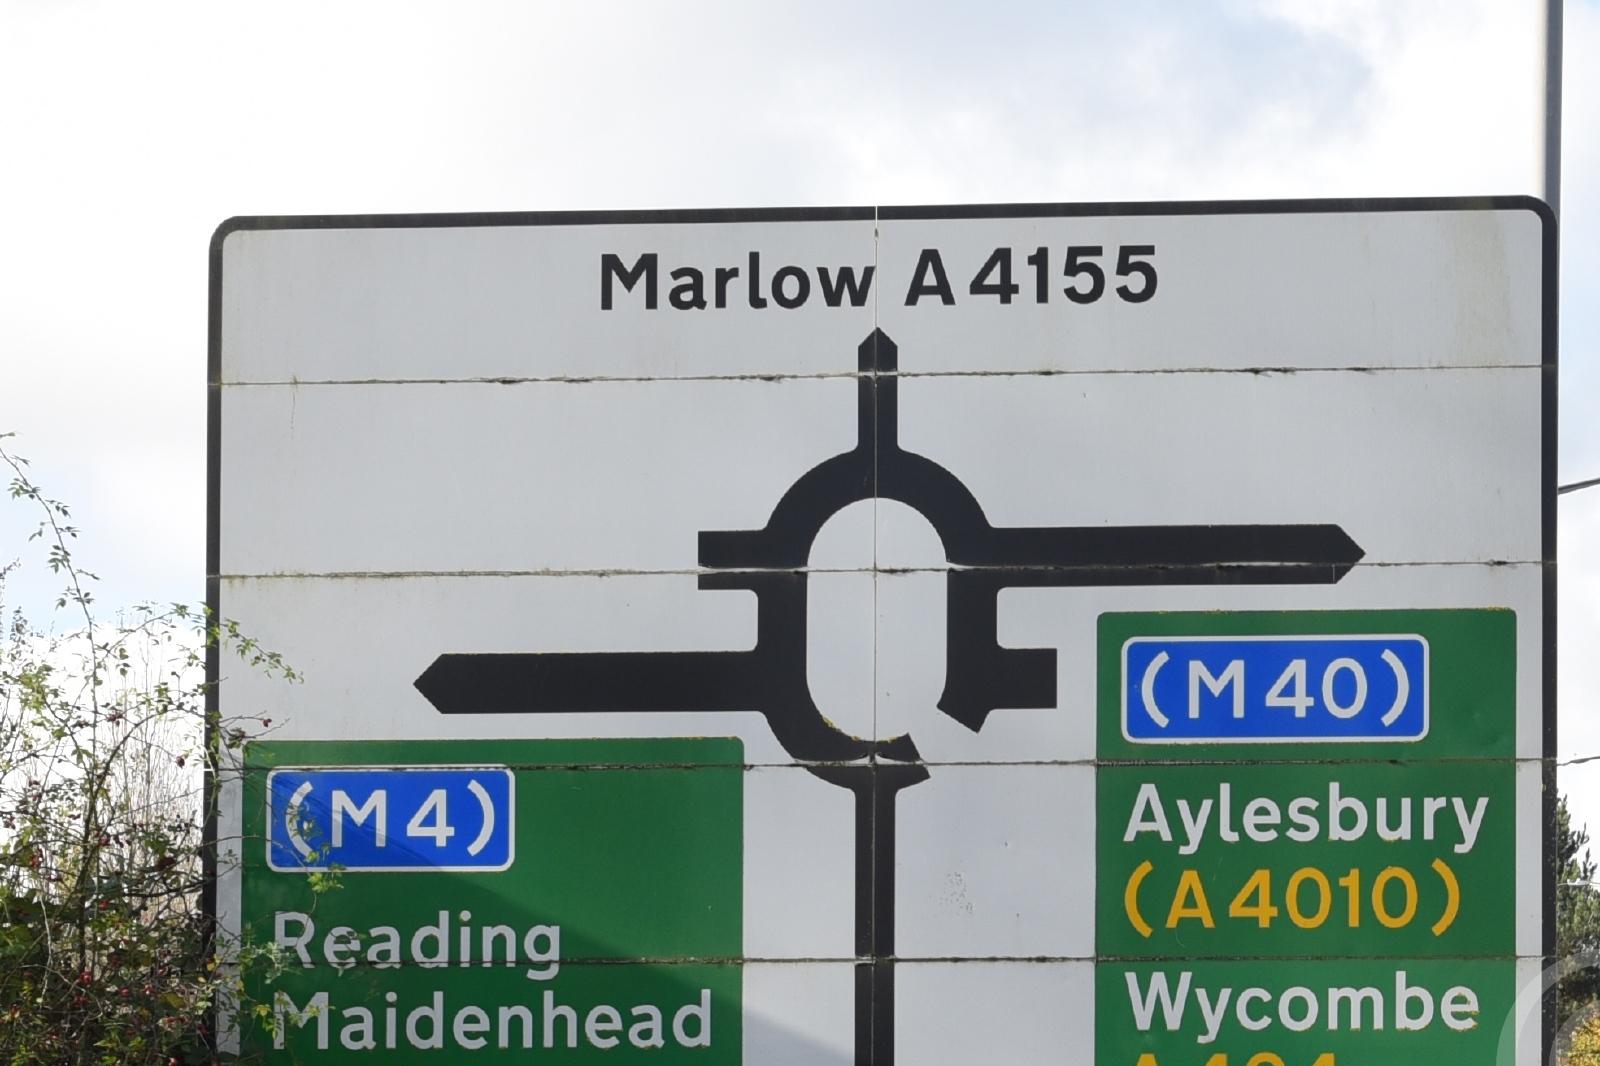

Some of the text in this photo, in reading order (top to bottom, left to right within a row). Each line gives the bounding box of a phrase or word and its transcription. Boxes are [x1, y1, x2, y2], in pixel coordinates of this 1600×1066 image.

[601, 250, 876, 311] Marlow
[1123, 782, 1489, 855] Aylesbury
[273, 910, 561, 980] Reading
[273, 989, 712, 1051] Maidenhead
[1124, 971, 1480, 1044] Wycombe
